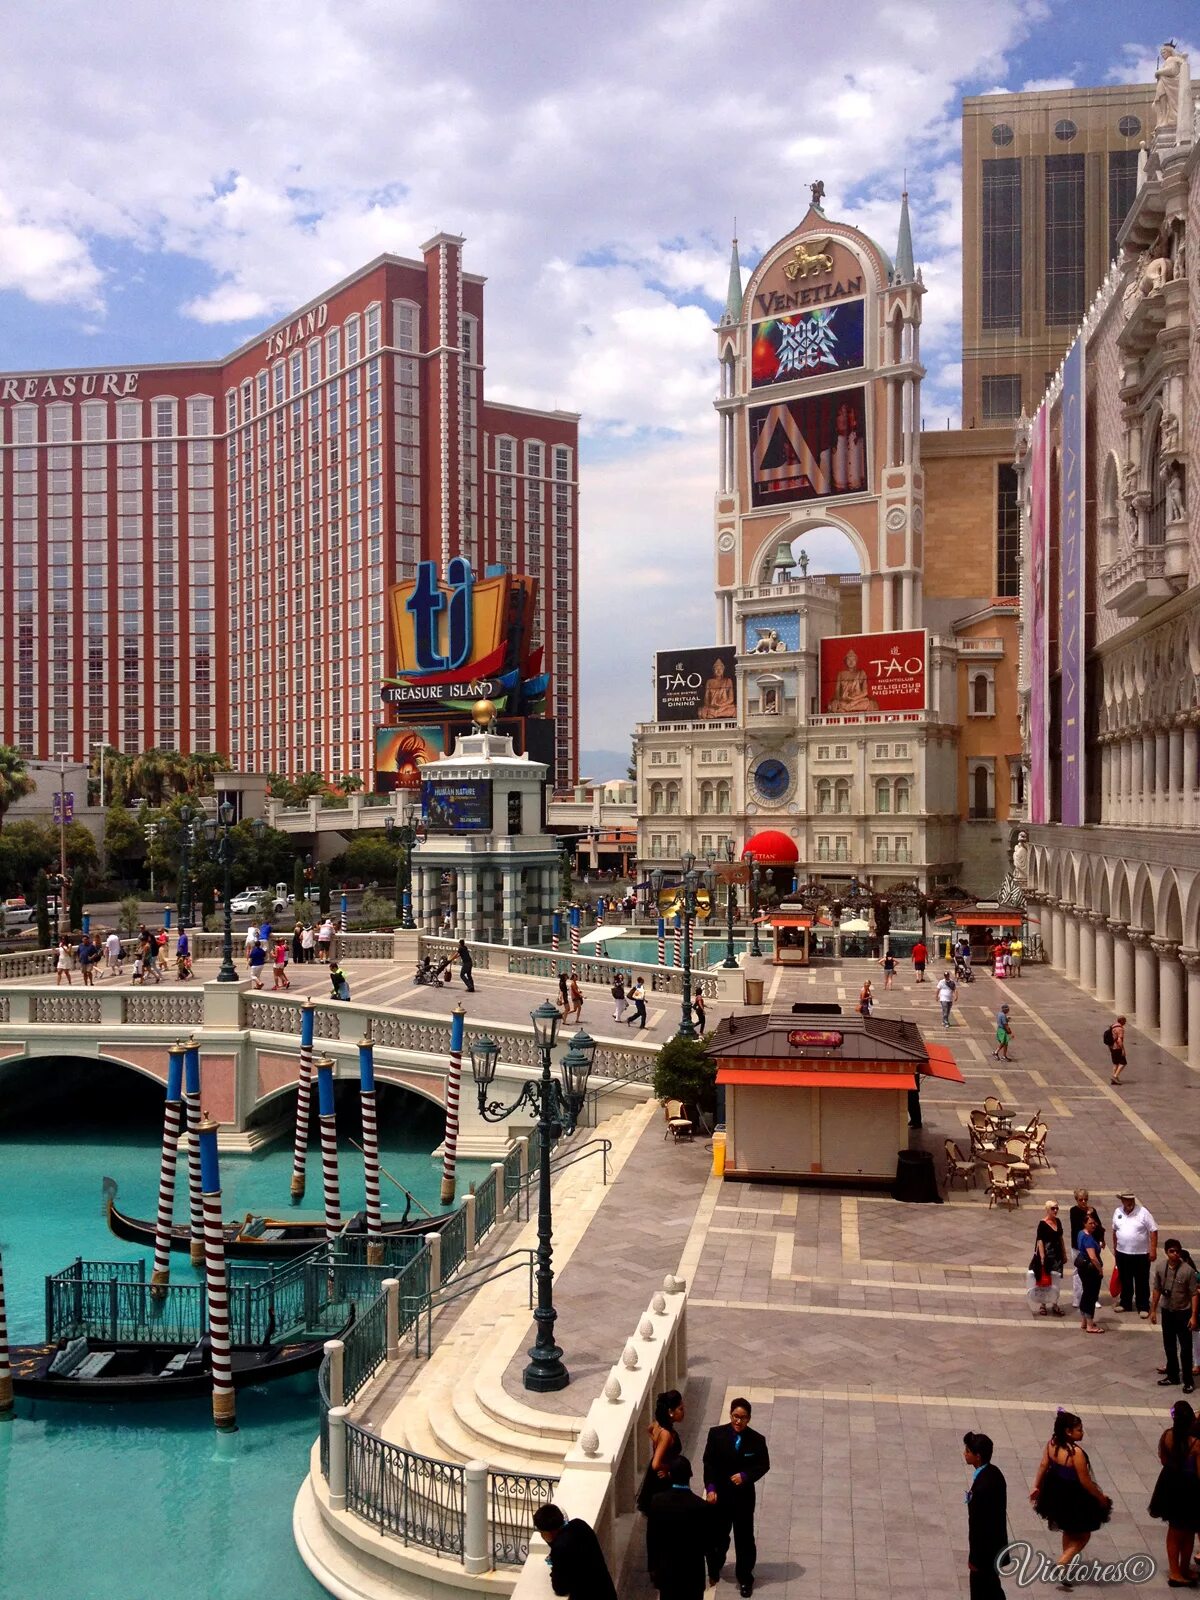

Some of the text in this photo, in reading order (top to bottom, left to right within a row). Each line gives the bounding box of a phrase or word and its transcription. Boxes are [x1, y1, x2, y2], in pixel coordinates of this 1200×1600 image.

[757, 276, 862, 316] VENETIAN
[265, 303, 328, 360] ISLAND
[776, 307, 839, 351] ROCK
[802, 339, 811, 347] OF
[774, 339, 839, 379] AGES
[1, 373, 139, 402] REASURE
[1066, 394, 1077, 782] CARNEVALE
[869, 657, 923, 677] TAO
[659, 673, 702, 690] TAO
[871, 683, 921, 691] RELIGIOUS
[388, 685, 443, 701] TREASURE
[872, 688, 920, 696] NIGHTLIFE
[434, 787, 476, 796] HUMAN NATURE
